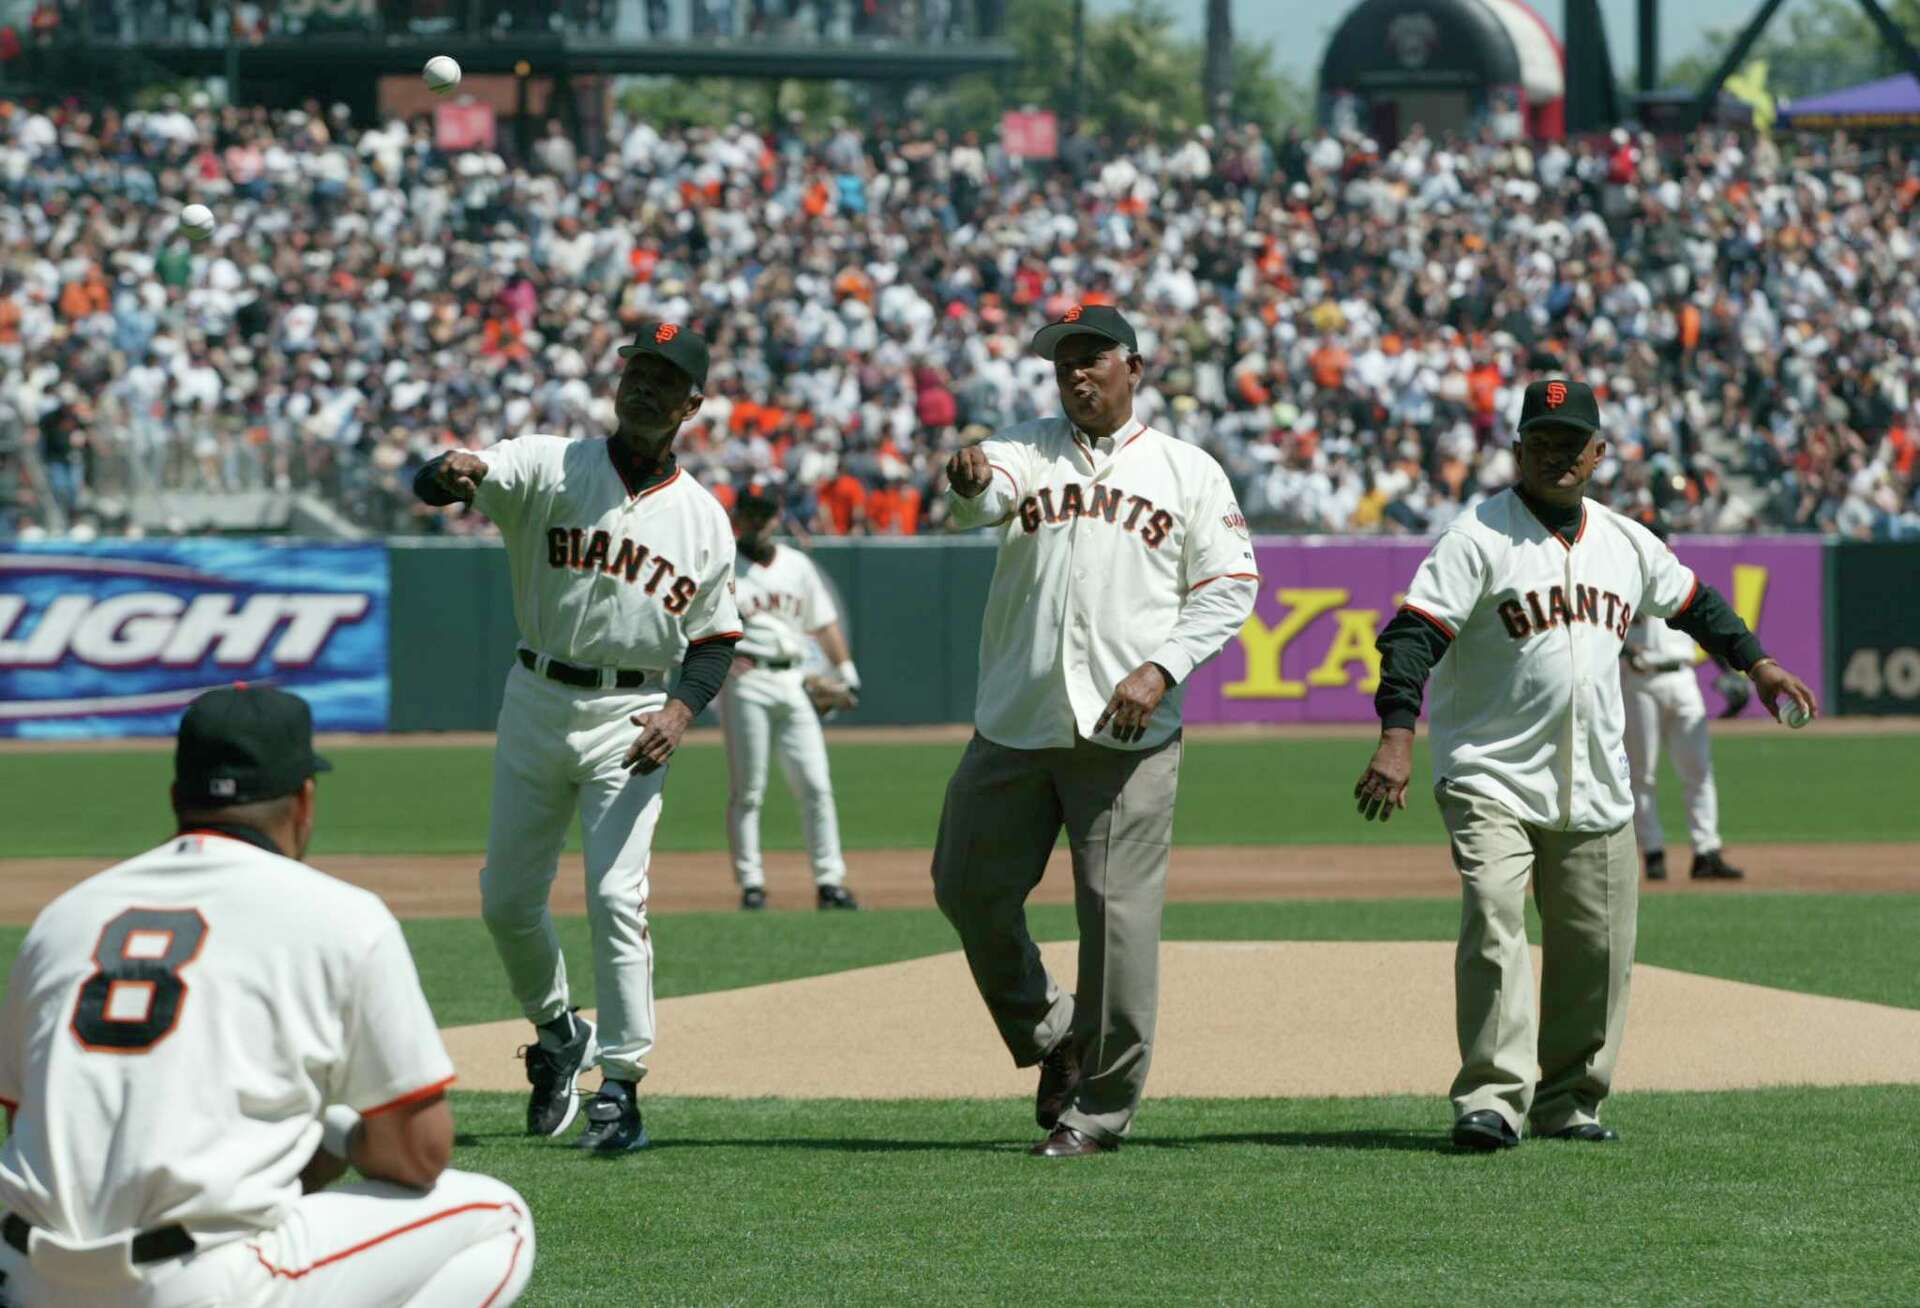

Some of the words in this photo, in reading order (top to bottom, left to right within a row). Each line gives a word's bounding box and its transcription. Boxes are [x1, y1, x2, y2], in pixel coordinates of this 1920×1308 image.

[1019, 482, 1174, 549] GIANTS
[547, 526, 698, 616] GIANTS
[1497, 583, 1630, 641] GIANTS
[69, 906, 210, 1055] 8
